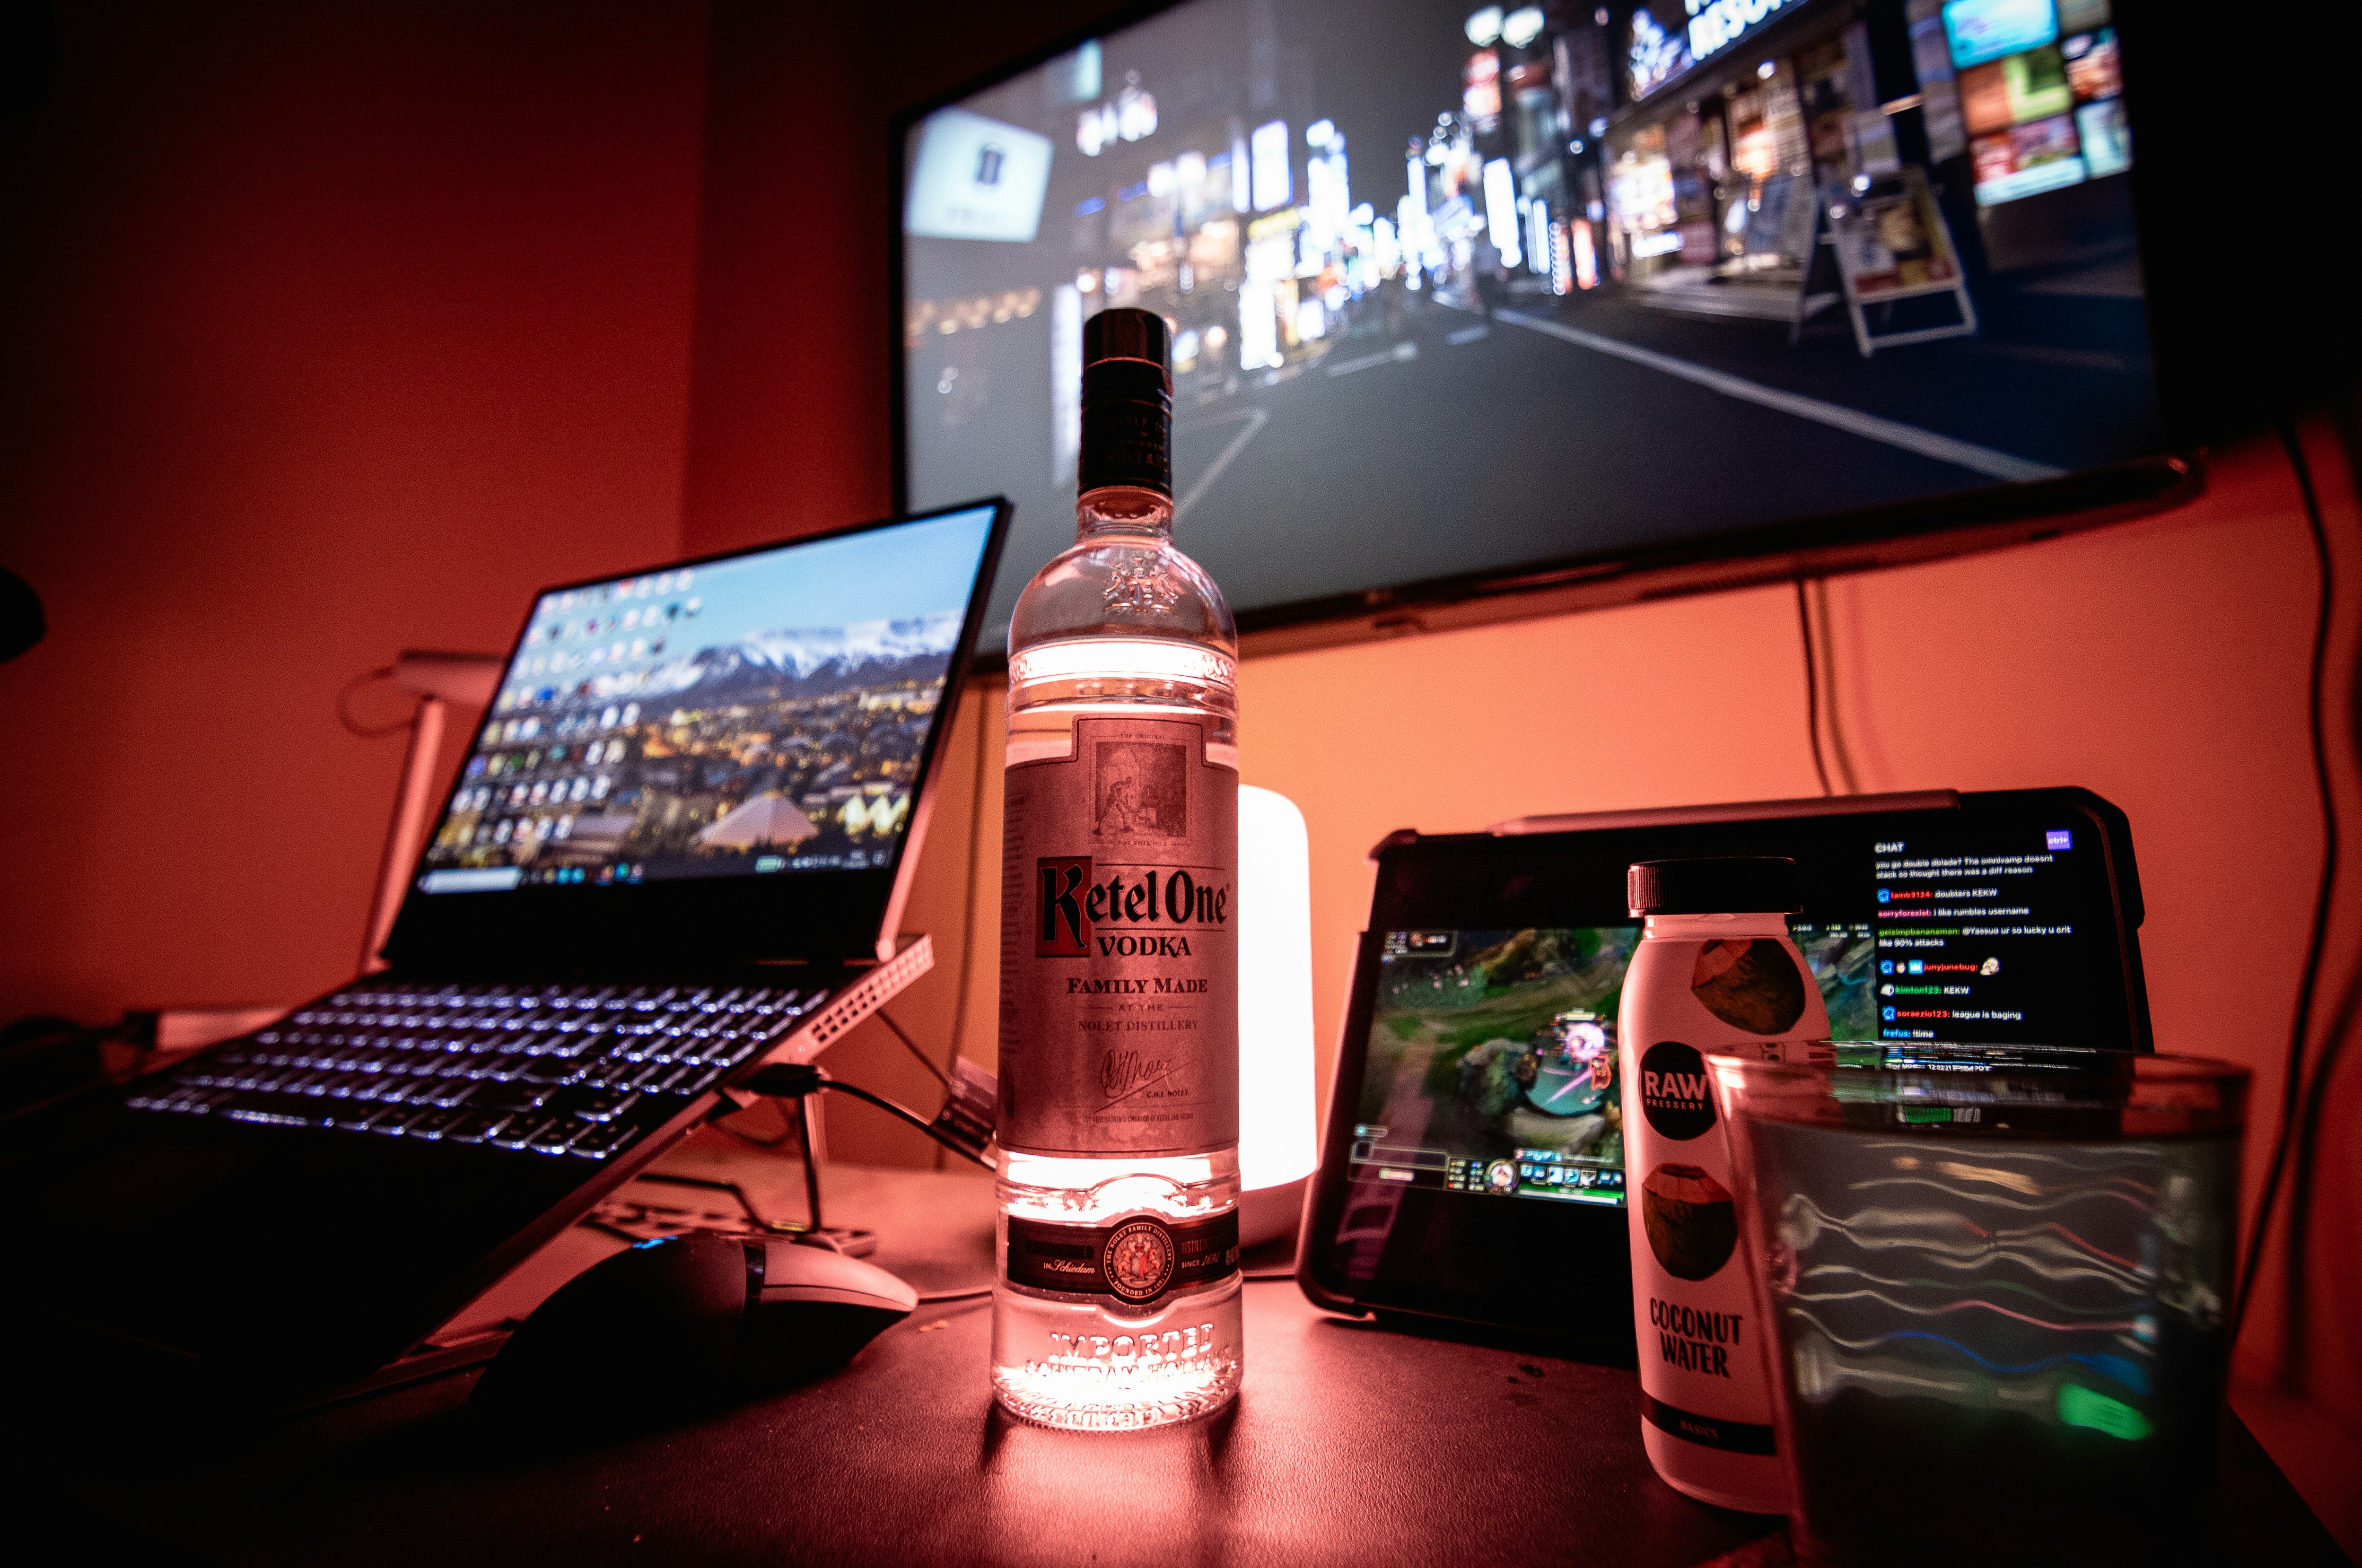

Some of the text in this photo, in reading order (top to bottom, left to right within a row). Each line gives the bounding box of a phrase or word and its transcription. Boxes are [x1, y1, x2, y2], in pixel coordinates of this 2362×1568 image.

[1874, 842, 1904, 853] CHAT
[1875, 854, 2054, 870] you go double dblade? The omnivamp doesnt
[1876, 871, 1897, 880] stack
[1898, 871, 1908, 879] so
[1909, 869, 1940, 879] thought
[1941, 868, 1962, 877] there
[1964, 868, 1980, 876] was
[1988, 866, 2003, 875] diff
[2004, 865, 2033, 874] reason
[1934, 889, 1970, 898] doubters
[1972, 888, 1997, 897] KEKW
[1041, 864, 1228, 950] Ketel One
[1938, 907, 1952, 916] like
[1953, 906, 1986, 916] rumbles
[1988, 906, 2030, 915] username
[1962, 926, 1999, 936] @Yassuo
[2001, 927, 2010, 935] ur
[2012, 926, 2022, 935] so
[2024, 925, 2046, 935] lucky
[2048, 926, 2055, 934] u
[2056, 925, 2072, 934] crit
[1096, 935, 1192, 958] VODKA
[1879, 938, 1945, 947] like 90% attacks
[1067, 977, 1208, 994] FAMILY MADE
[1943, 985, 1969, 995] KEKW
[1118, 1003, 1164, 1012] AT THE
[1951, 1009, 1980, 1020] league
[1982, 1009, 1990, 1019] is
[1991, 1009, 2022, 1021] baging
[1078, 1020, 1198, 1032] NOLET DISTILLERY
[1644, 1070, 1708, 1100] RAW
[1167, 1089, 1188, 1097] NOLET
[1646, 1098, 1704, 1110] PRESSERY
[1153, 1228, 1172, 1261] DISTILLERY
[1051, 1259, 1095, 1274] Schiedam
[1181, 1260, 1199, 1268] SINCE
[1114, 1281, 1143, 1296] FOUNDED
[1650, 1298, 1743, 1345] COCONUT
[1049, 1323, 1214, 1365] IMPORTED
[1660, 1331, 1730, 1378] WATER
[1680, 1419, 1718, 1439] BASICS
